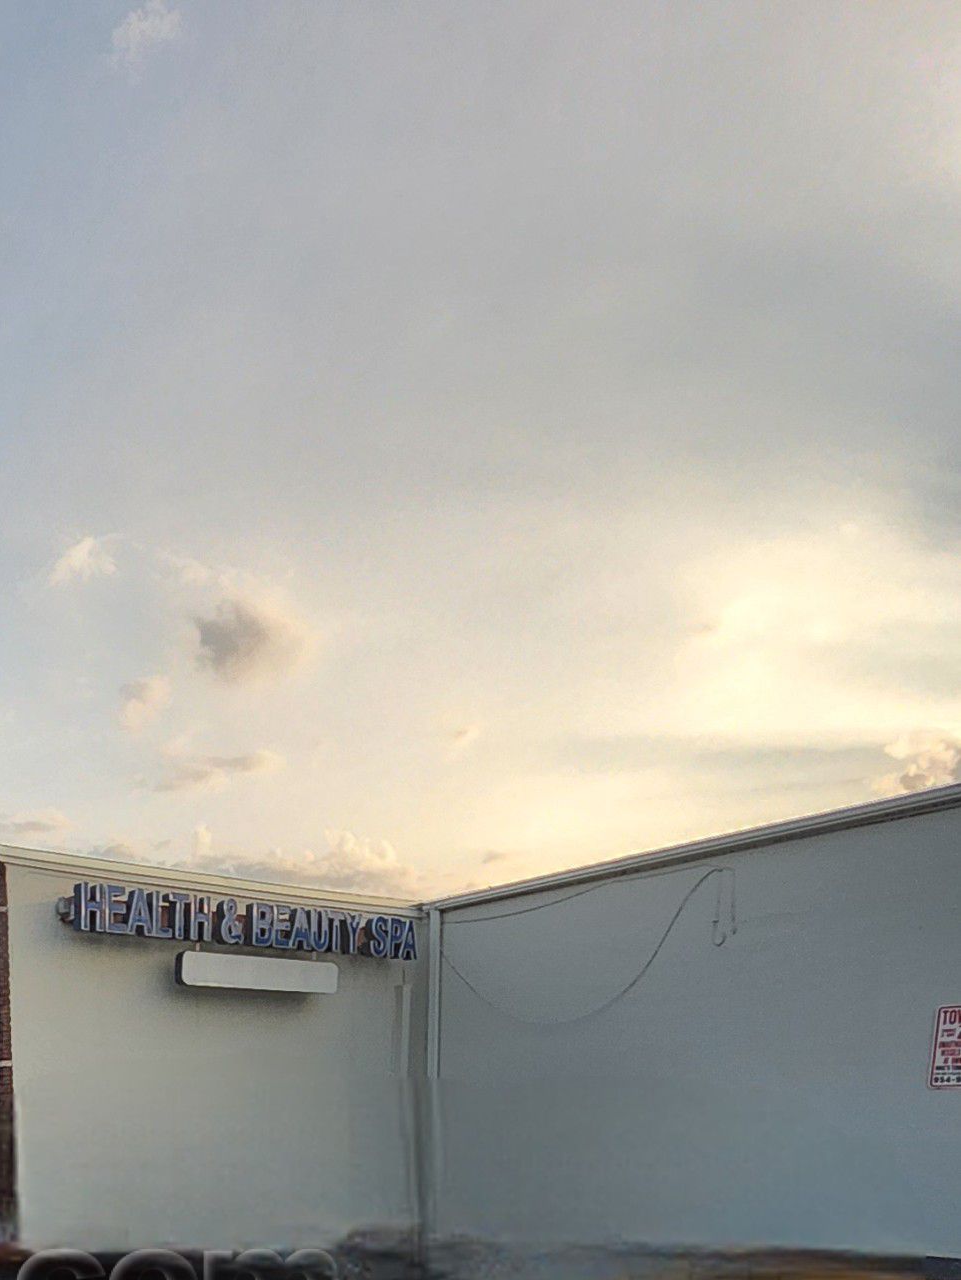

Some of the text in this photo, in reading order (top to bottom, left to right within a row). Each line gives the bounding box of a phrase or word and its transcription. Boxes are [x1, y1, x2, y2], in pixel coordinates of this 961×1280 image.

[75, 881, 418, 960] HEALTH & BEAUTY SPA
